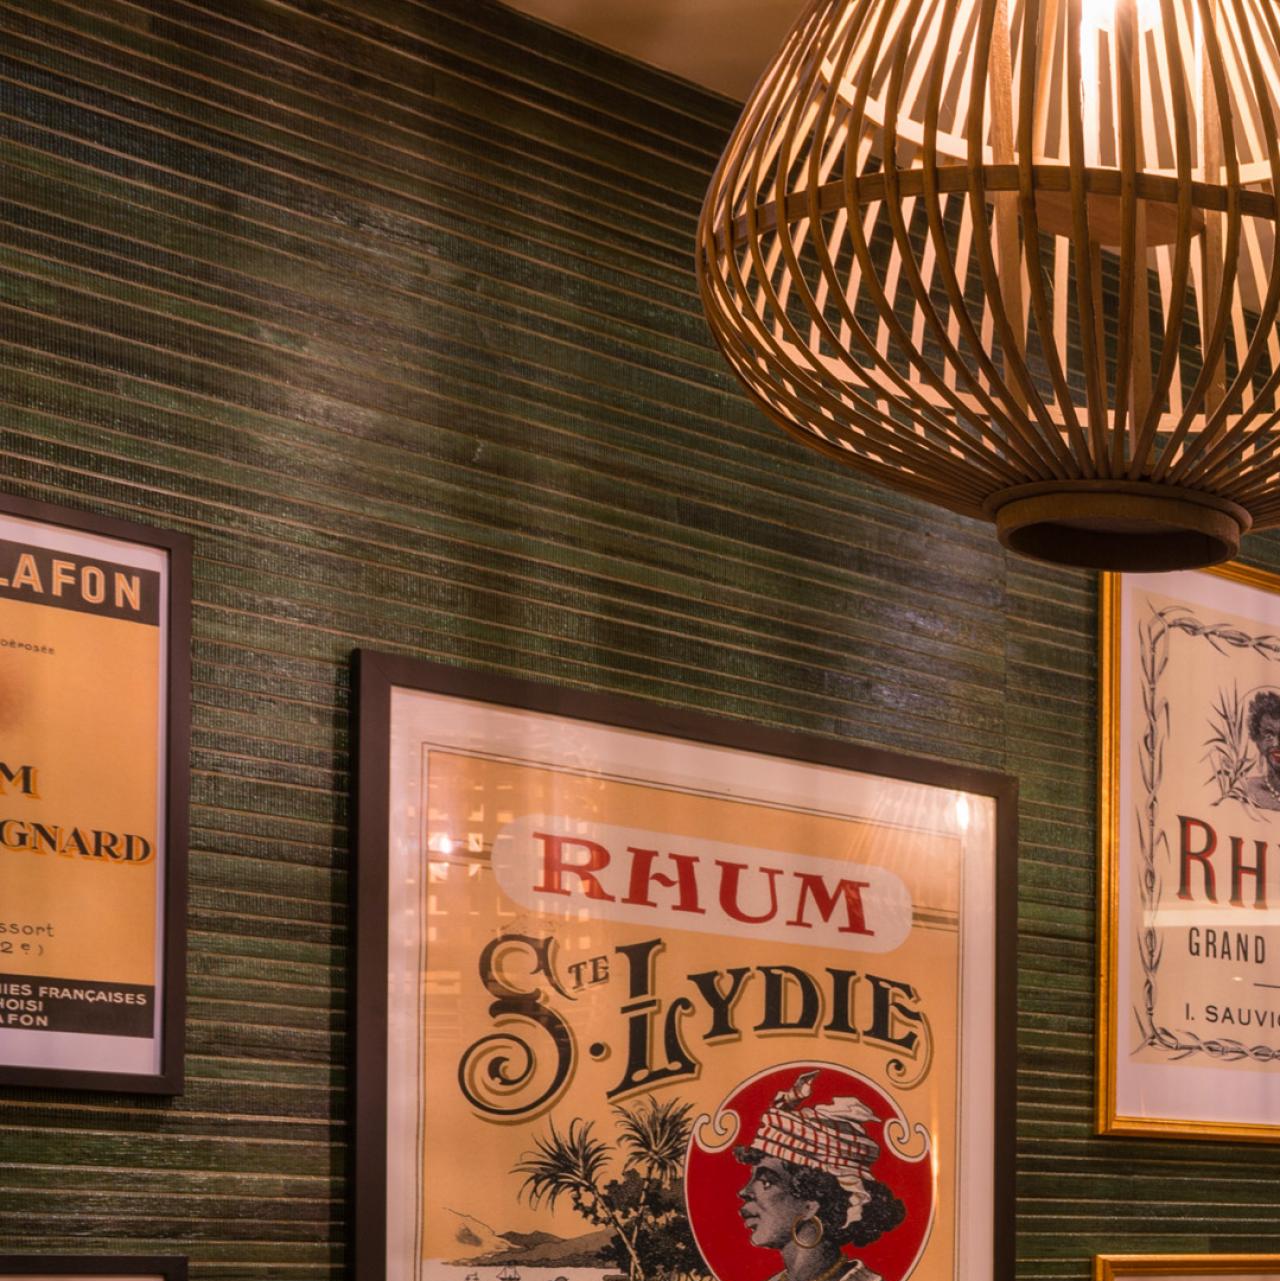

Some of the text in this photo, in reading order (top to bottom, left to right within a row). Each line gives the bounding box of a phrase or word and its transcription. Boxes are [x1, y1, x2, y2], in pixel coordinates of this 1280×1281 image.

[0, 553, 141, 612] AFON
[532, 832, 875, 937] RHUM
[1188, 927, 1265, 964] GRAND
[0, 984, 32, 996] IES
[38, 986, 147, 1006] FRANÇAISES
[606, 938, 933, 1103] LYDIE
